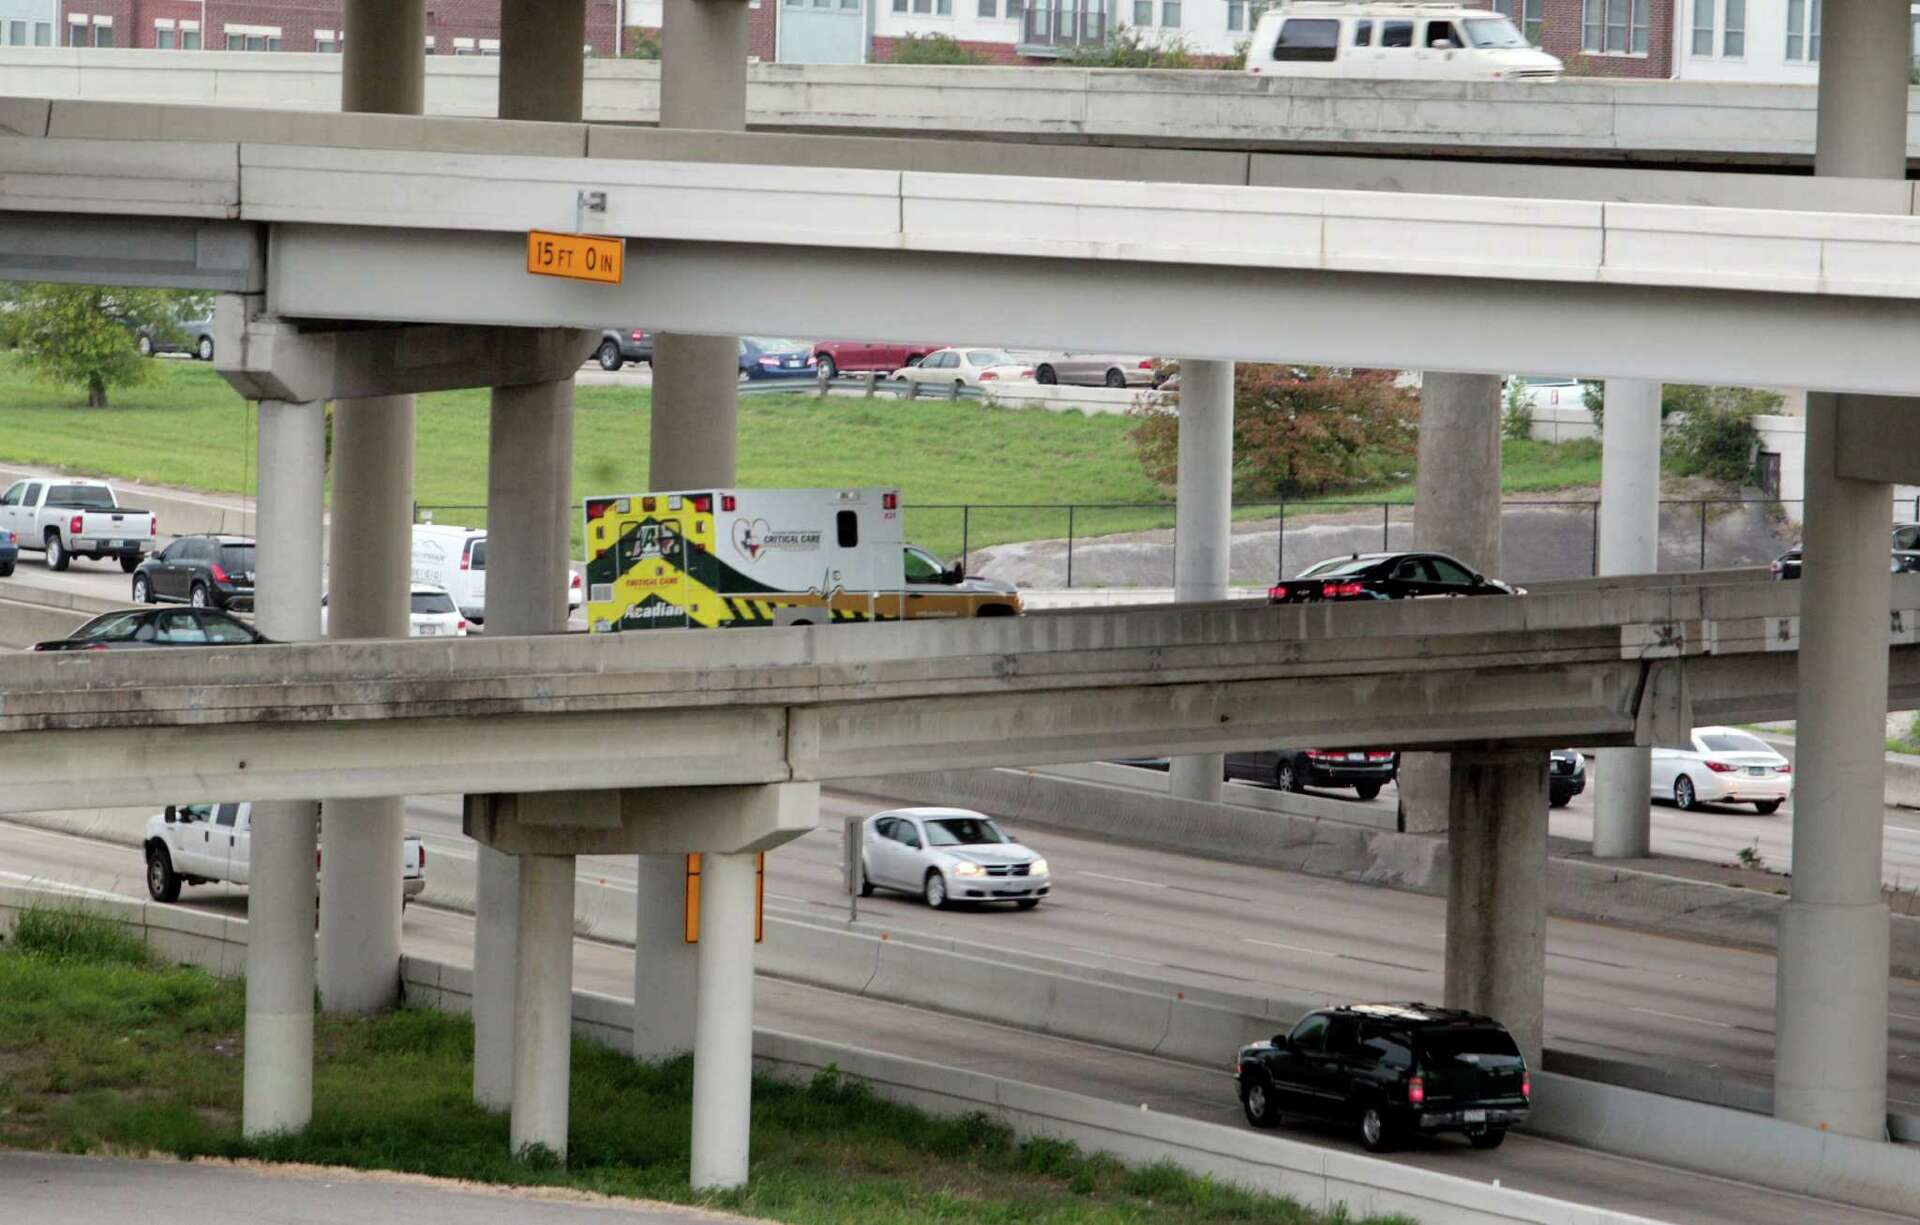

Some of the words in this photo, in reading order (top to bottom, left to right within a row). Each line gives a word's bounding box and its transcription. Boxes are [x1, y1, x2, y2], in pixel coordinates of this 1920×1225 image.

[536, 241, 554, 266] 15
[558, 249, 574, 268] FT
[585, 246, 597, 271] 0
[600, 254, 613, 273] IN
[763, 535, 799, 544] CRITICAL
[800, 534, 821, 544] CARE
[624, 602, 684, 619] Acadian
